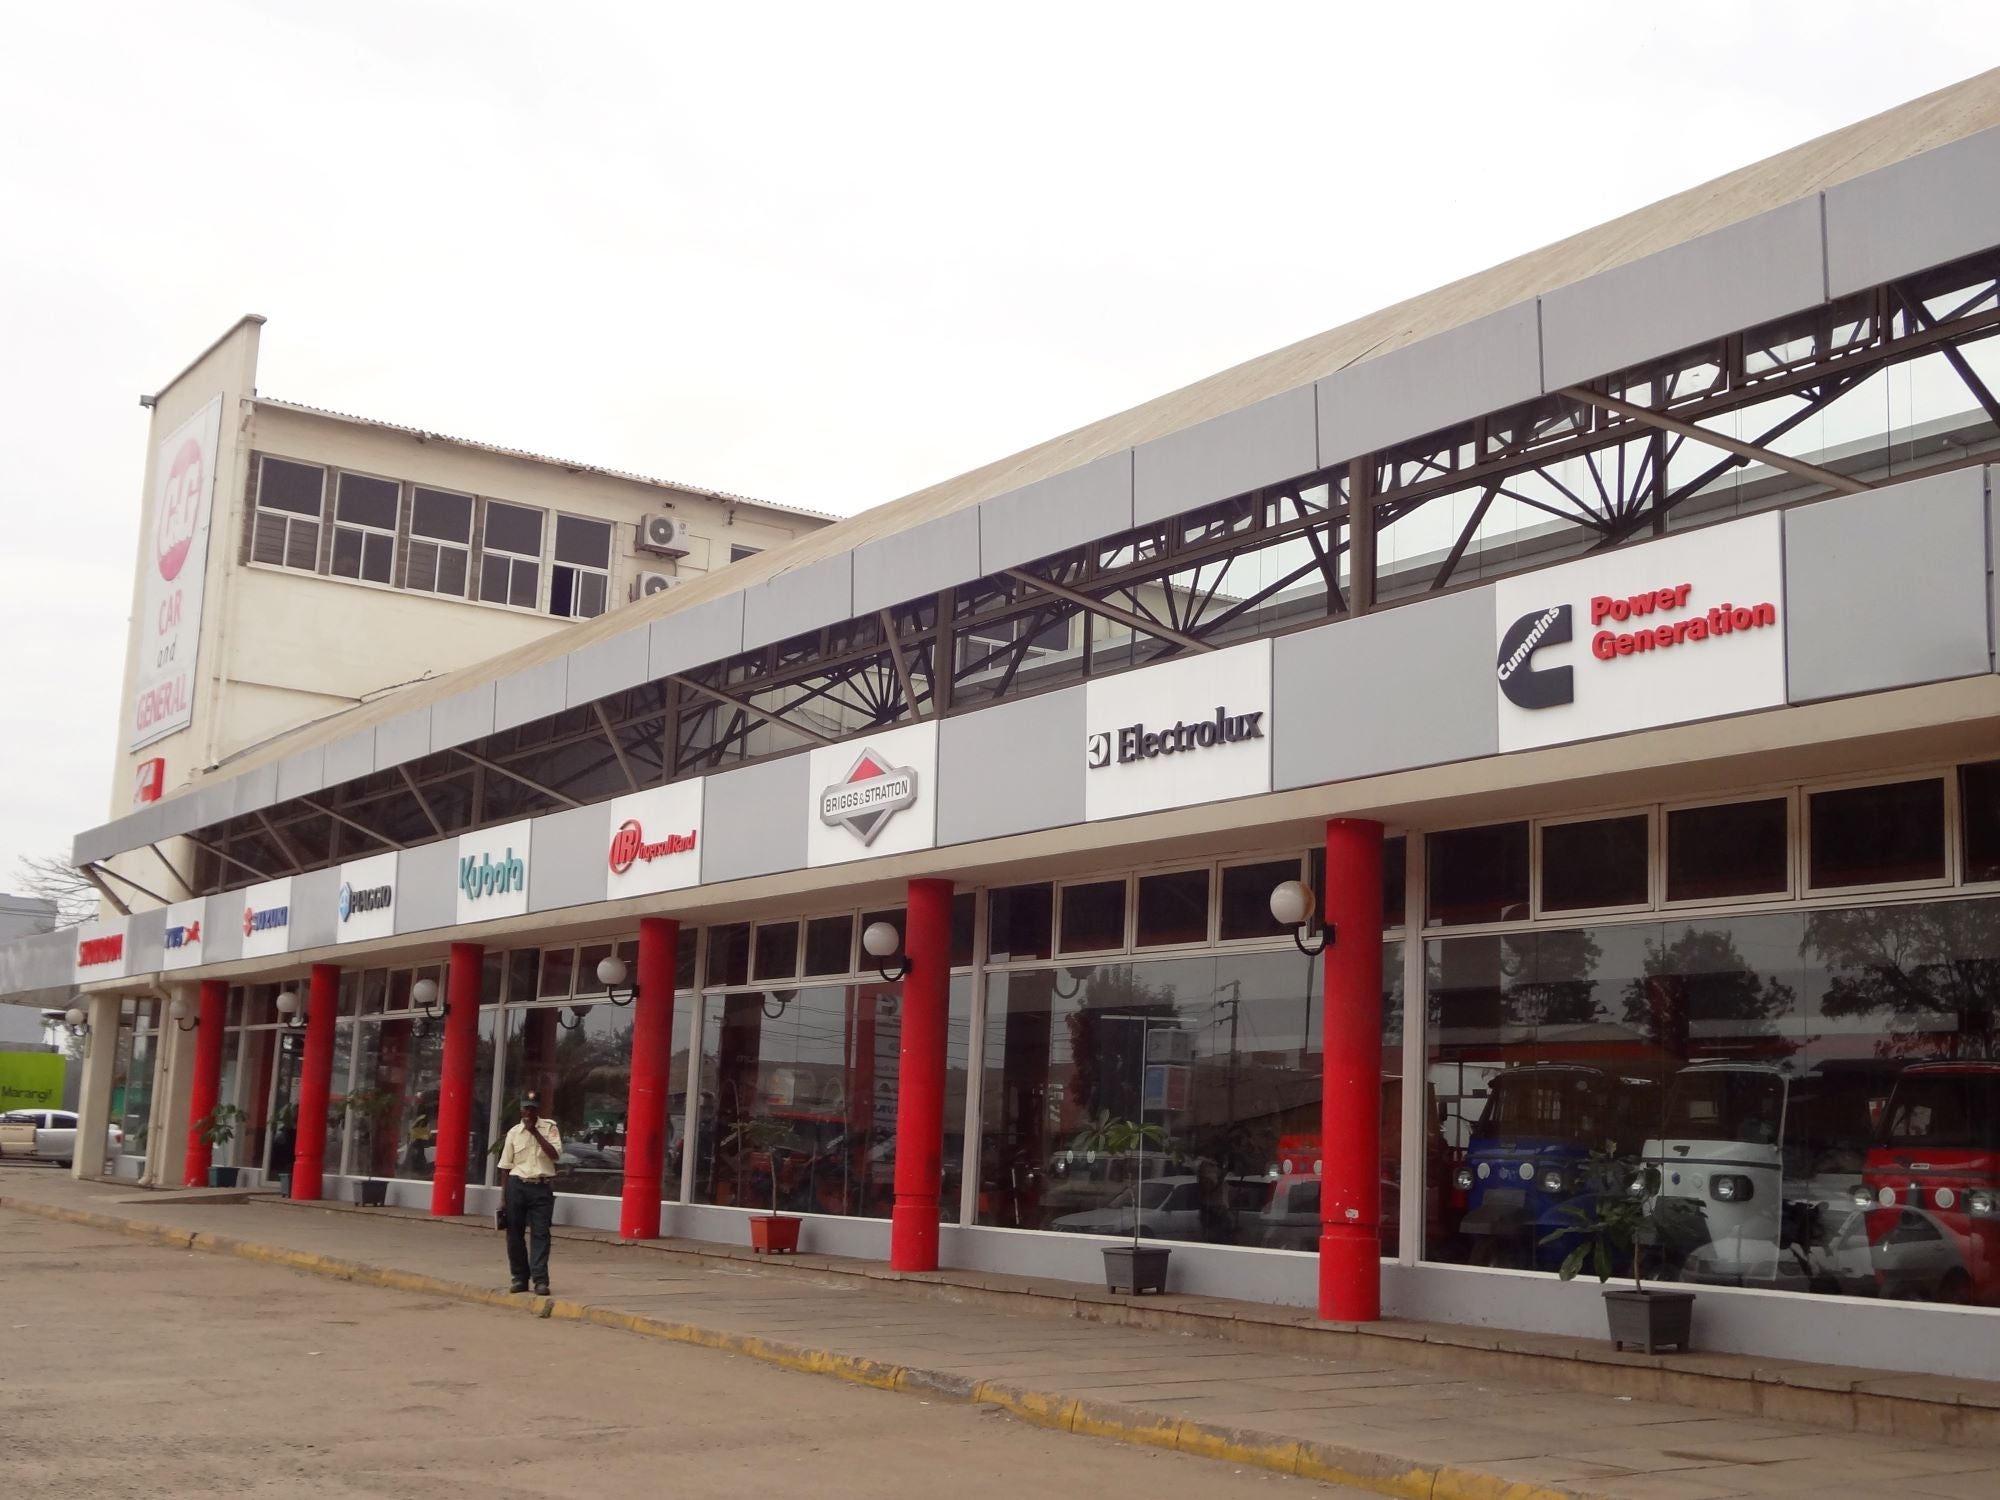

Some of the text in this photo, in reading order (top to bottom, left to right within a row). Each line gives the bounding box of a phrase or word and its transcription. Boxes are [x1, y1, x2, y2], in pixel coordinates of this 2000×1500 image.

[158, 589, 183, 636] CAR
[1591, 583, 1692, 625] Power
[157, 633, 178, 668] and
[1497, 605, 1560, 681] Cummins
[1592, 602, 1776, 660] Generation
[136, 673, 188, 731] GENERAL
[1117, 706, 1264, 763] Electrolux
[459, 847, 524, 900] Kubota
[252, 906, 288, 931] SUZUKI
[350, 885, 392, 914] PIAGGIO
